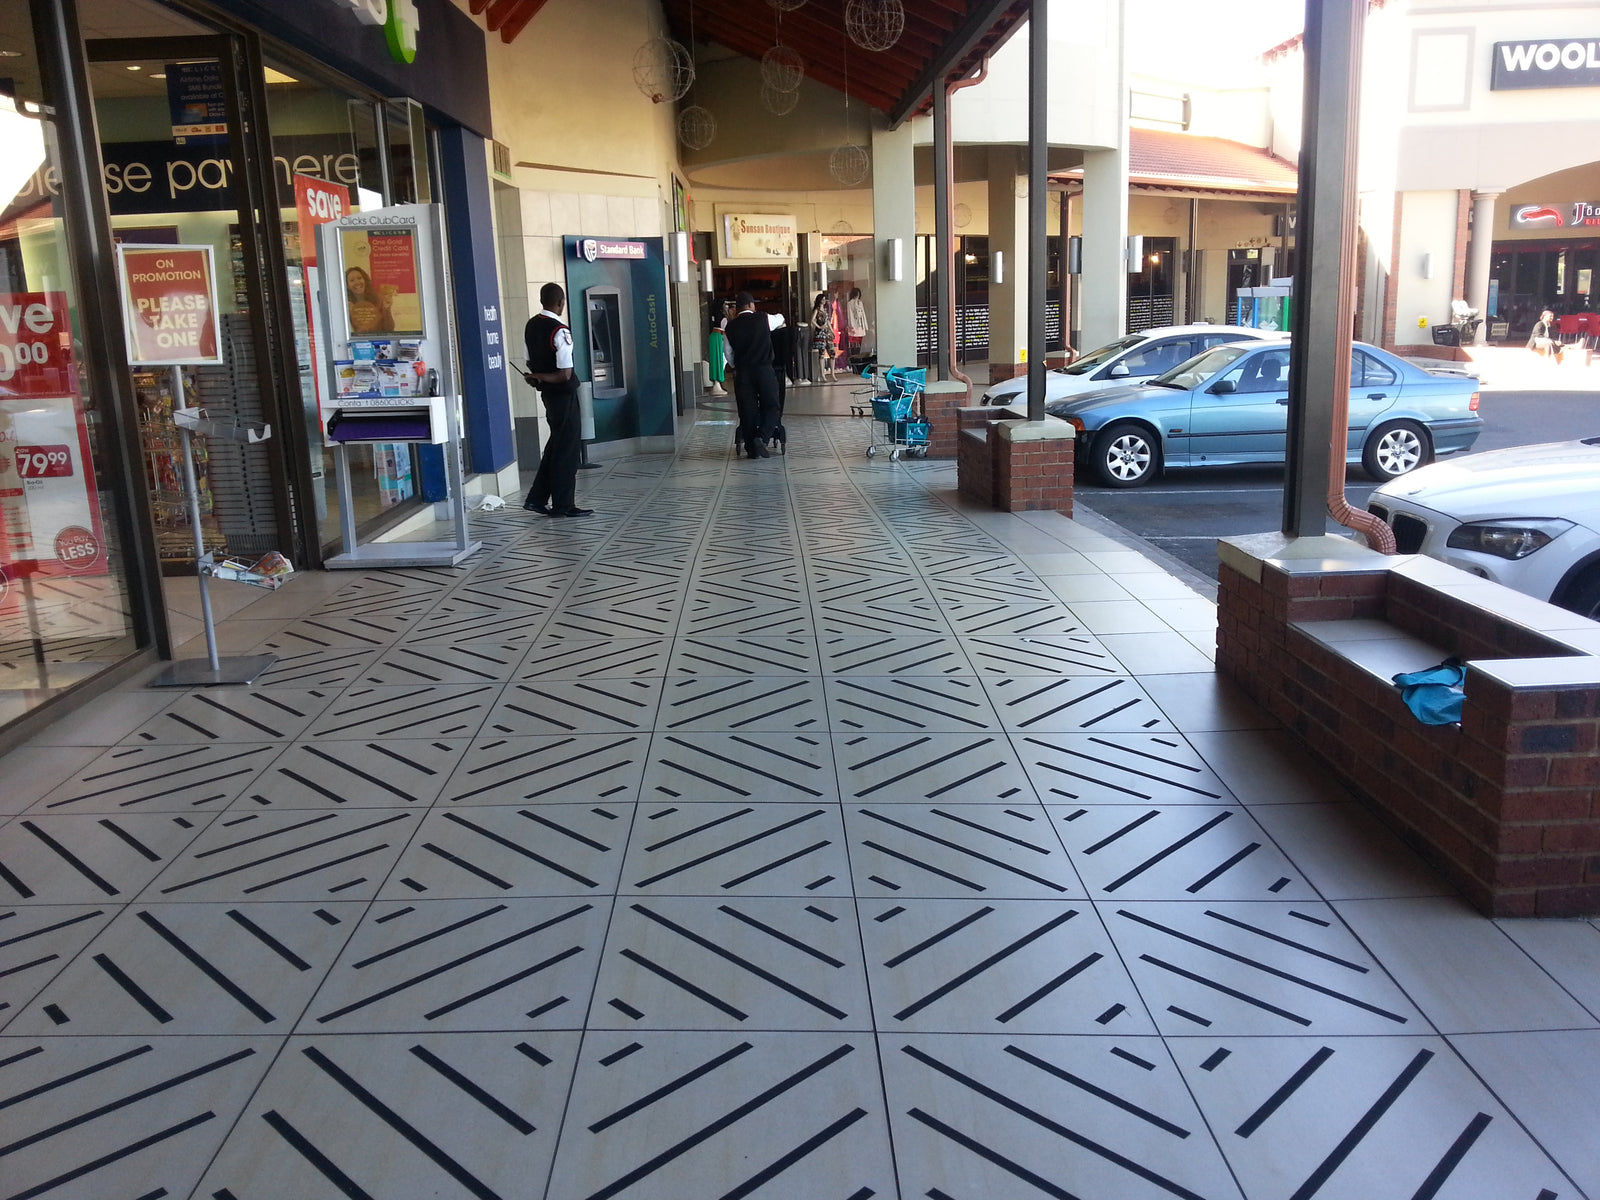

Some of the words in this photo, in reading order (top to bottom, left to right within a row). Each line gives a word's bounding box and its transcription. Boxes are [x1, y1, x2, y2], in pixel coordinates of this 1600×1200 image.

[1501, 42, 1600, 71] WOOL
[306, 187, 342, 219] save
[340, 216, 367, 226] Clicks
[369, 215, 416, 225] ClubCard
[600, 244, 628, 255] Standard
[629, 245, 644, 255] Bank
[156, 259, 174, 269] ON
[132, 270, 201, 283] PROMOTION
[137, 294, 206, 313] PLEASE
[149, 313, 198, 330] TAKE
[646, 294, 658, 348] AutoCash
[157, 331, 199, 348] ONE
[338, 399, 369, 407] Contat
[61, 542, 95, 561] LESS
